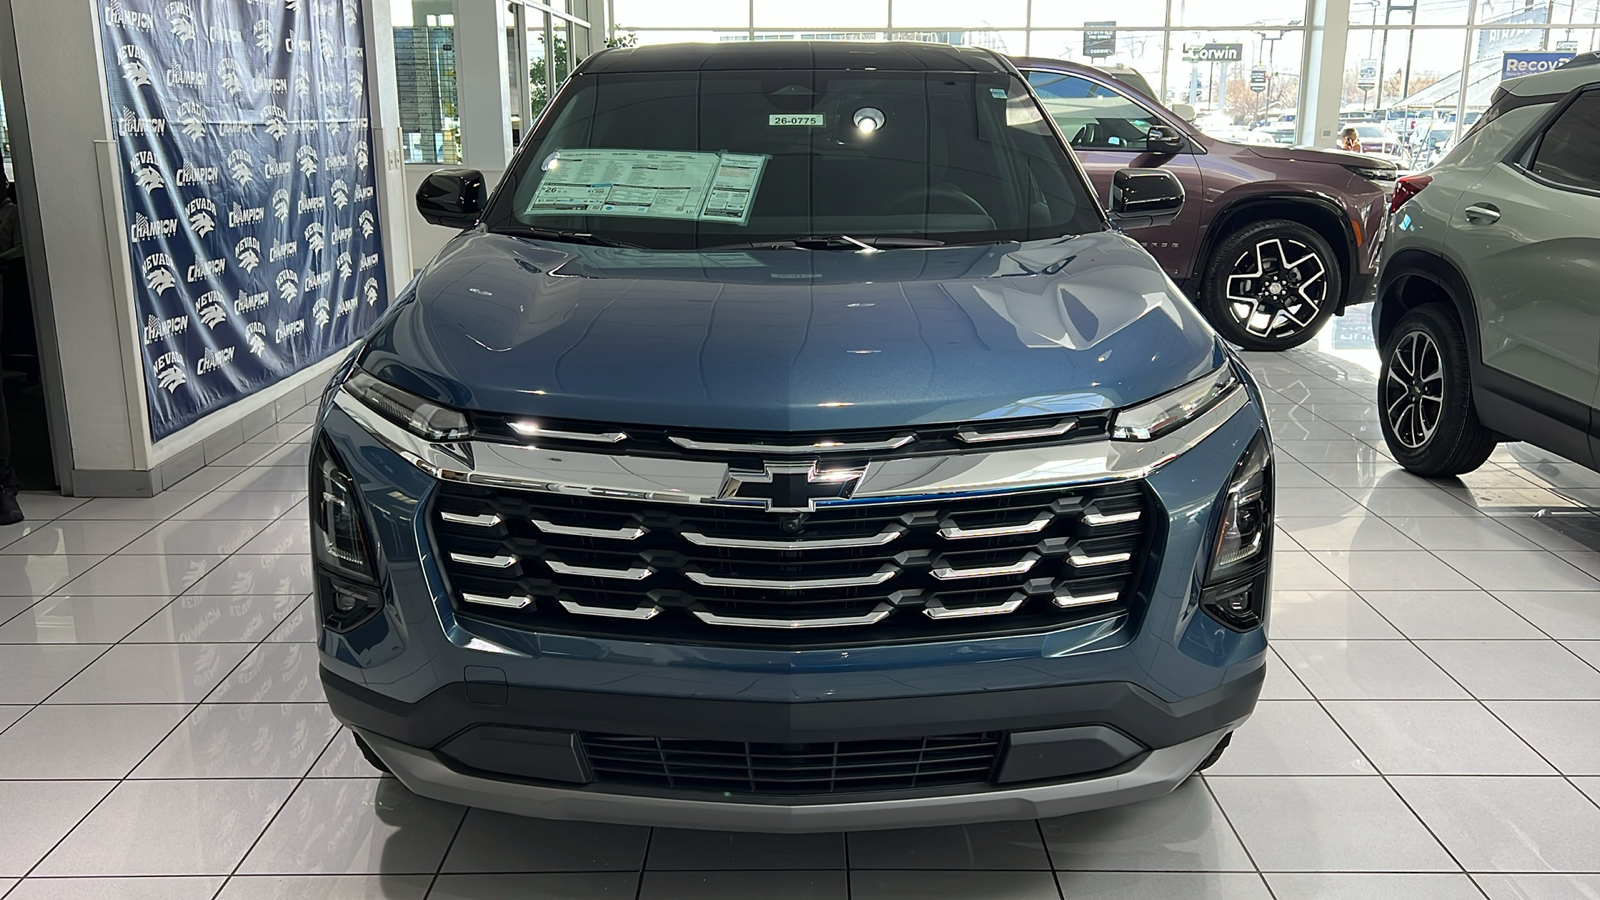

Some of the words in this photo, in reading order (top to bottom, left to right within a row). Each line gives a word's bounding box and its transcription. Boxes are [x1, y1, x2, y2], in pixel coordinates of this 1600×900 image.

[105, 7, 154, 29] CHAMPION
[1188, 45, 1238, 60] Corwin
[166, 69, 208, 87] CHAMPION
[774, 116, 817, 125] 26-0775
[176, 167, 219, 187] CHAMPION
[185, 198, 217, 219] NEVADA
[229, 207, 264, 228] CHAMPION
[131, 219, 178, 243] CHAMPION
[235, 236, 260, 259] NEVADA
[187, 258, 226, 283] CHAMPION
[234, 291, 269, 316] CHAMPION
[144, 315, 188, 346] CHAMPION
[197, 346, 235, 376] CHAMPION
